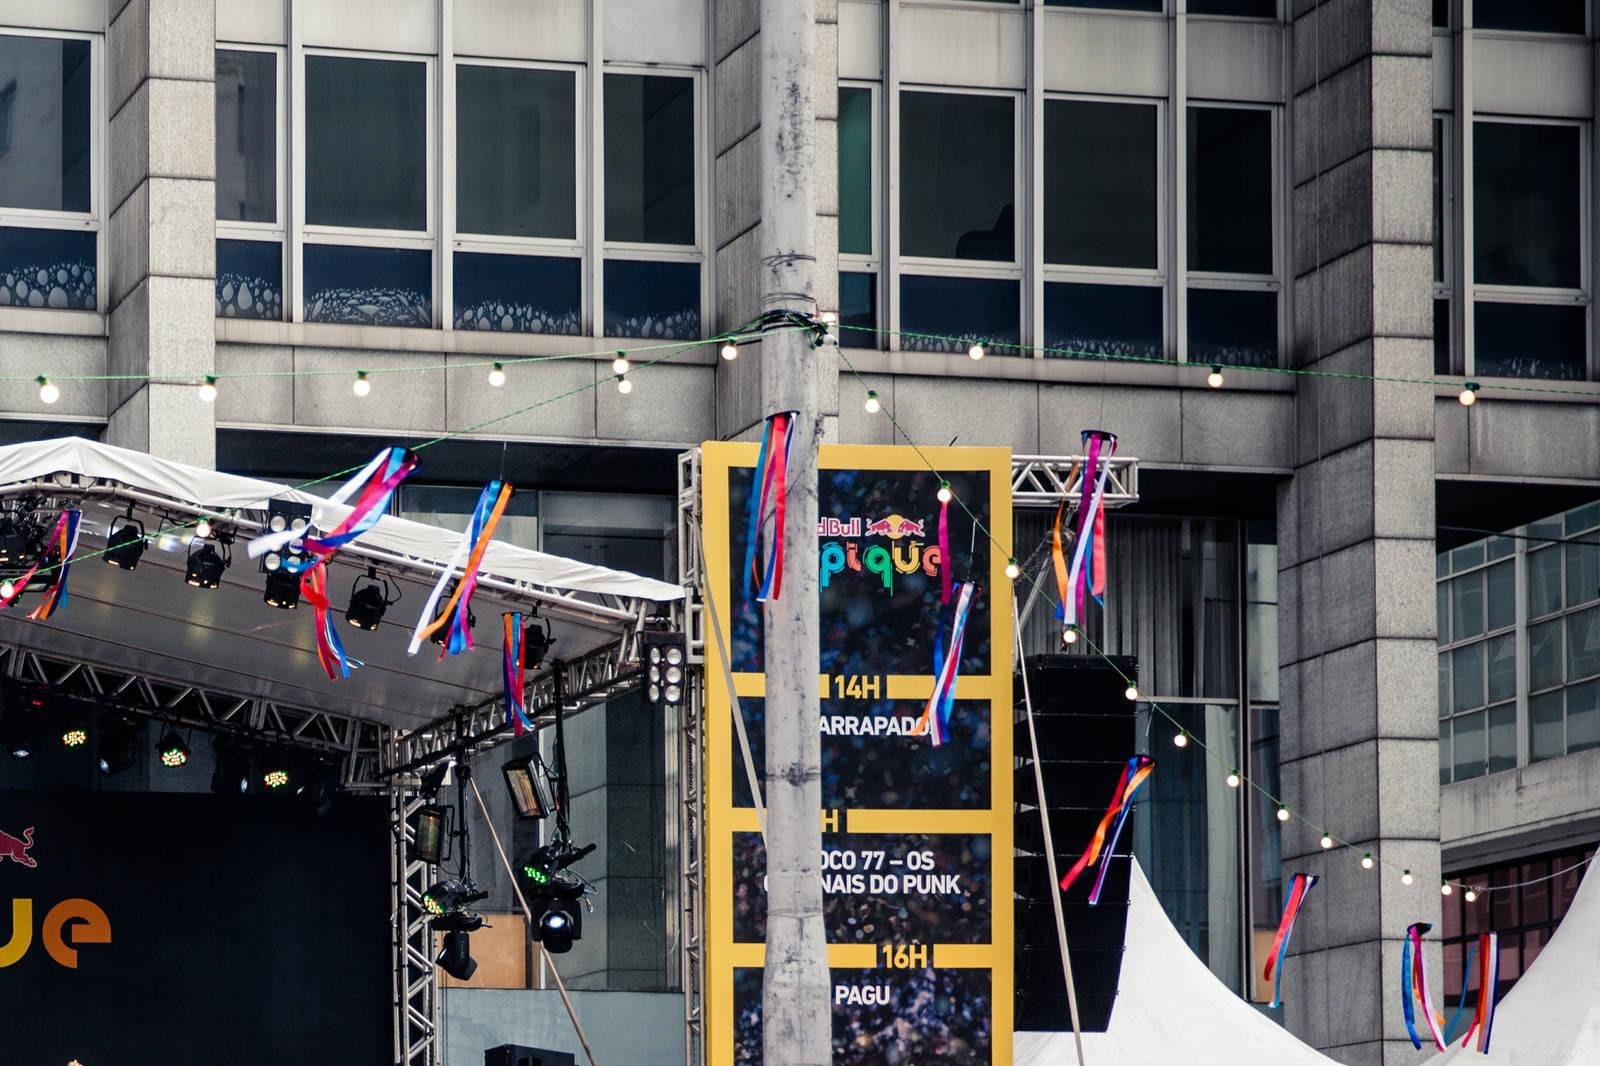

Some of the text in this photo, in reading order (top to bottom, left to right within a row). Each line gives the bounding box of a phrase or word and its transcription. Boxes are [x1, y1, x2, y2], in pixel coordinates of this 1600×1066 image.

[834, 675, 880, 699] 14H
[819, 715, 933, 736] ARRAPADO
[861, 850, 885, 870] 77
[906, 851, 935, 870] OS
[870, 875, 899, 894] DO
[903, 876, 961, 894] PUNK
[882, 944, 927, 968] 16H
[835, 985, 890, 1005] PAGU
